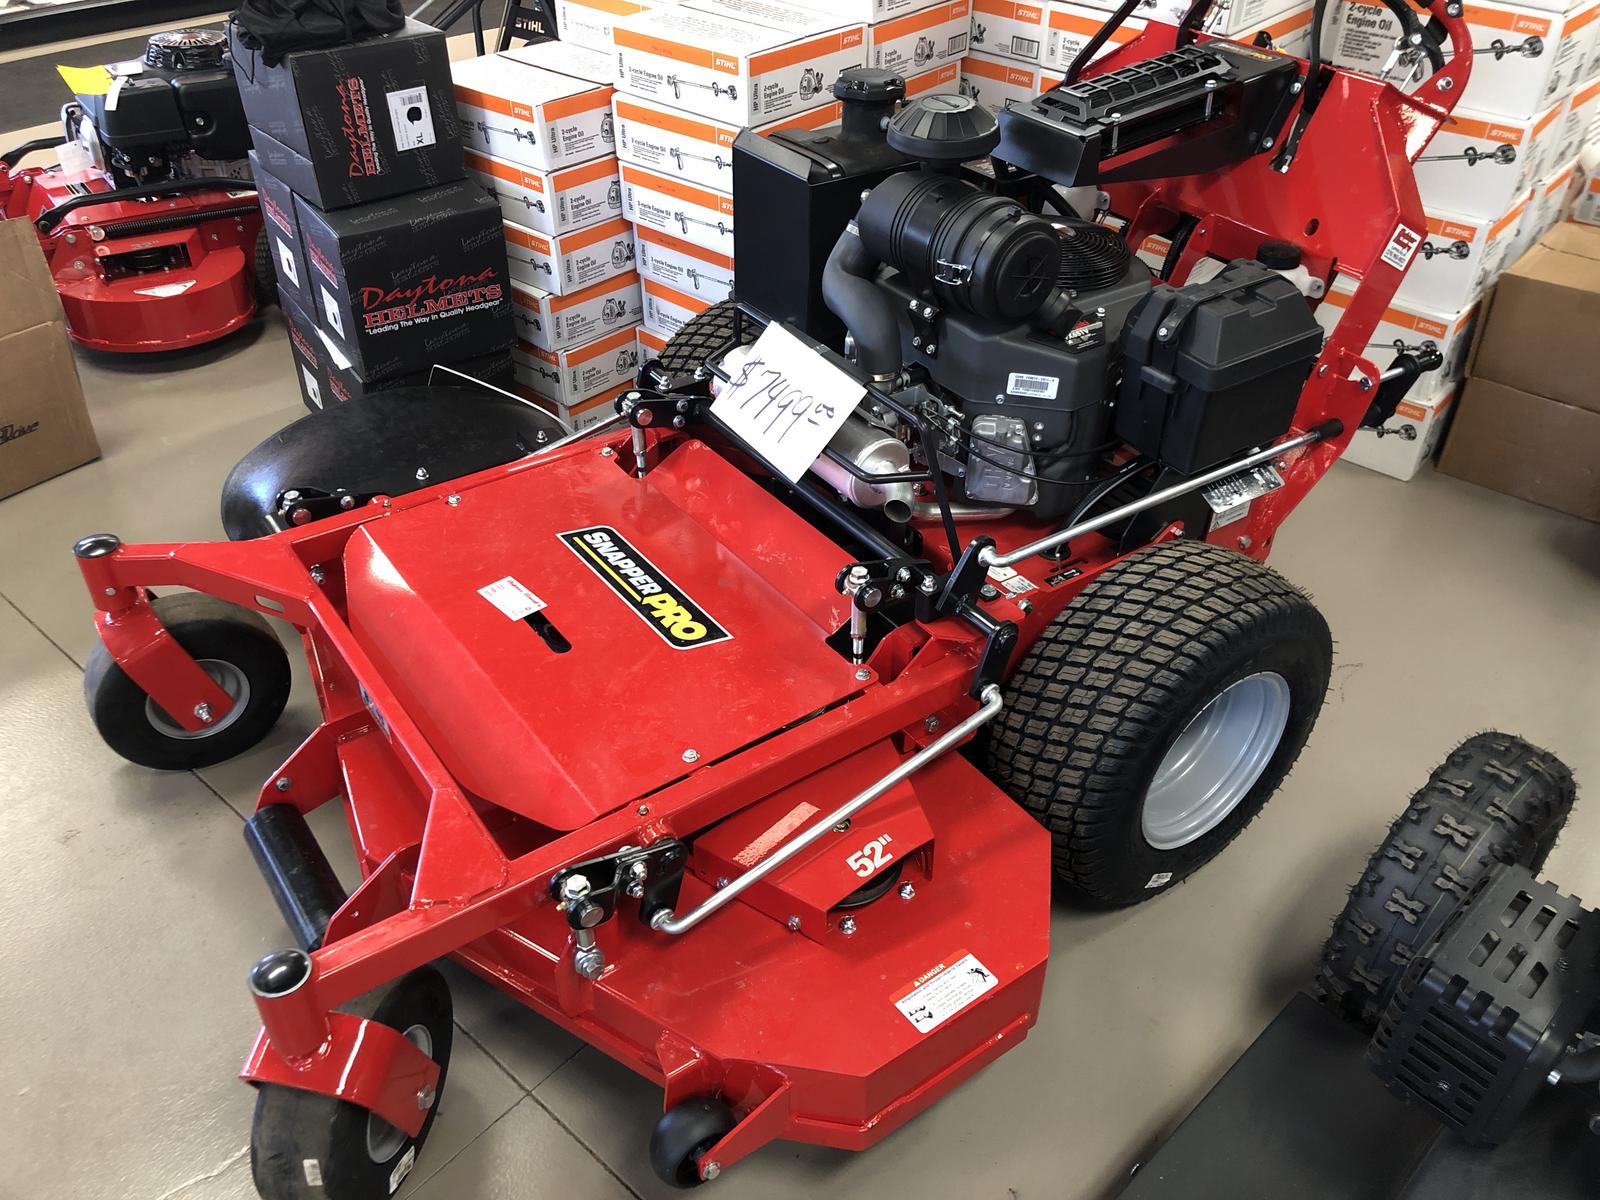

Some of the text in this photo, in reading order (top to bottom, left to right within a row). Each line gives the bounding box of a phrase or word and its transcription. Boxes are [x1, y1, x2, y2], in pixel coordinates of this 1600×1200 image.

[1017, 9, 1040, 20] STIHL
[1348, 1, 1383, 17] 2-cycle
[515, 16, 545, 34] STIHL
[1346, 13, 1377, 28] Engine
[1378, 19, 1393, 31] Oil
[1516, 20, 1545, 32] STIHL
[842, 33, 861, 45] STIHL
[715, 58, 737, 70] STIHL
[1009, 73, 1031, 84] STIHL
[513, 106, 532, 118] STIHL
[416, 132, 424, 145] XL
[1490, 129, 1519, 140] STIHL
[1445, 226, 1473, 237] STIHL
[361, 267, 499, 311] Daytona
[363, 284, 502, 328] HELMETS
[366, 323, 399, 336] "Leading
[400, 320, 413, 328] The
[414, 317, 430, 326] Way
[440, 308, 465, 319] Quality
[1417, 322, 1444, 334] STIHL
[583, 531, 708, 641] SNAPPER PRO
[845, 833, 893, 878] 52"
[918, 963, 946, 983] DANGER
